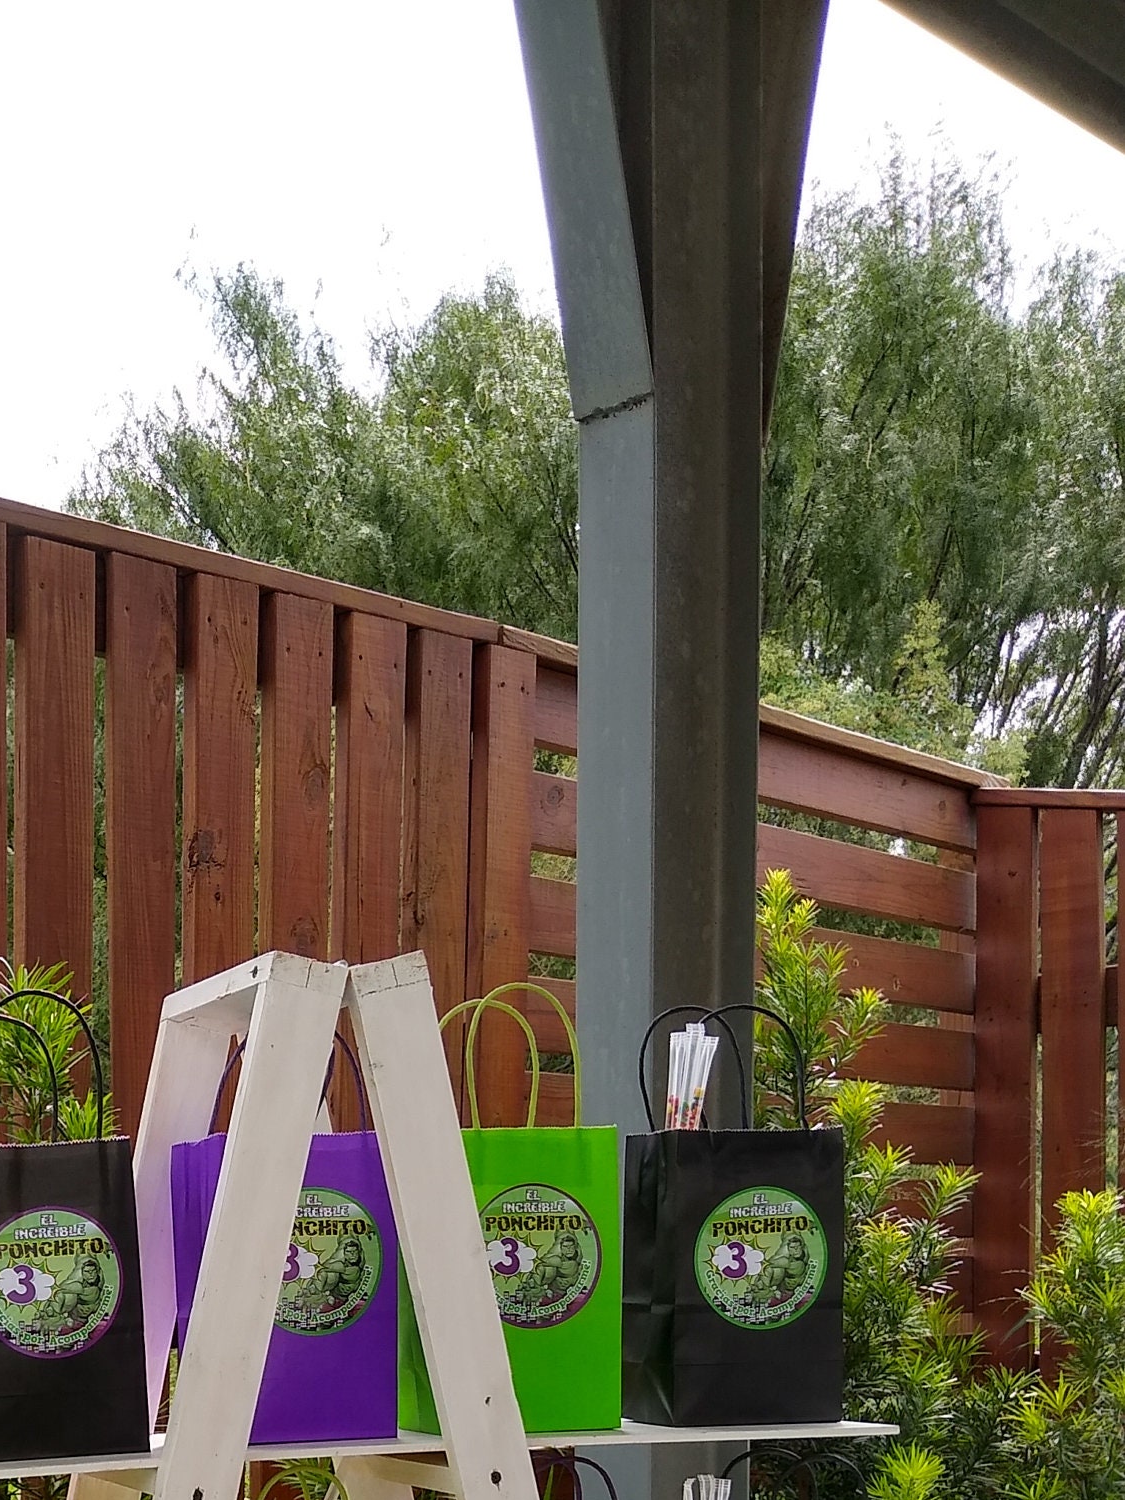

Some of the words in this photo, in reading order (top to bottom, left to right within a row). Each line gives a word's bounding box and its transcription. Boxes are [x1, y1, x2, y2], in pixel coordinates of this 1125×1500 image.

[306, 1194, 323, 1205] EL
[525, 1191, 541, 1200] EL
[752, 1195, 767, 1204] EL
[295, 1206, 349, 1218] CREIBLE
[503, 1201, 565, 1213] INCREIBLE
[729, 1203, 792, 1218] INCREIBLE
[40, 1215, 58, 1225] EL
[292, 1219, 365, 1237] NCHITO
[485, 1214, 581, 1232] PONCHITO
[712, 1216, 808, 1237] PONCHITO
[15, 1224, 85, 1239] INCREIBLE
[494, 1237, 519, 1275] 3
[722, 1242, 747, 1278] 3
[7, 1265, 35, 1304] 3
[285, 1311, 306, 1320] por
[311, 1265, 373, 1322] Acompañarme!
[506, 1305, 526, 1314] por
[531, 1260, 590, 1315] Acompañarme!
[706, 1269, 733, 1309] Gracias
[735, 1307, 755, 1315] por
[760, 1259, 817, 1316] Acompañarme!
[21, 1335, 44, 1344] por
[50, 1285, 113, 1345] Acompañarme!
